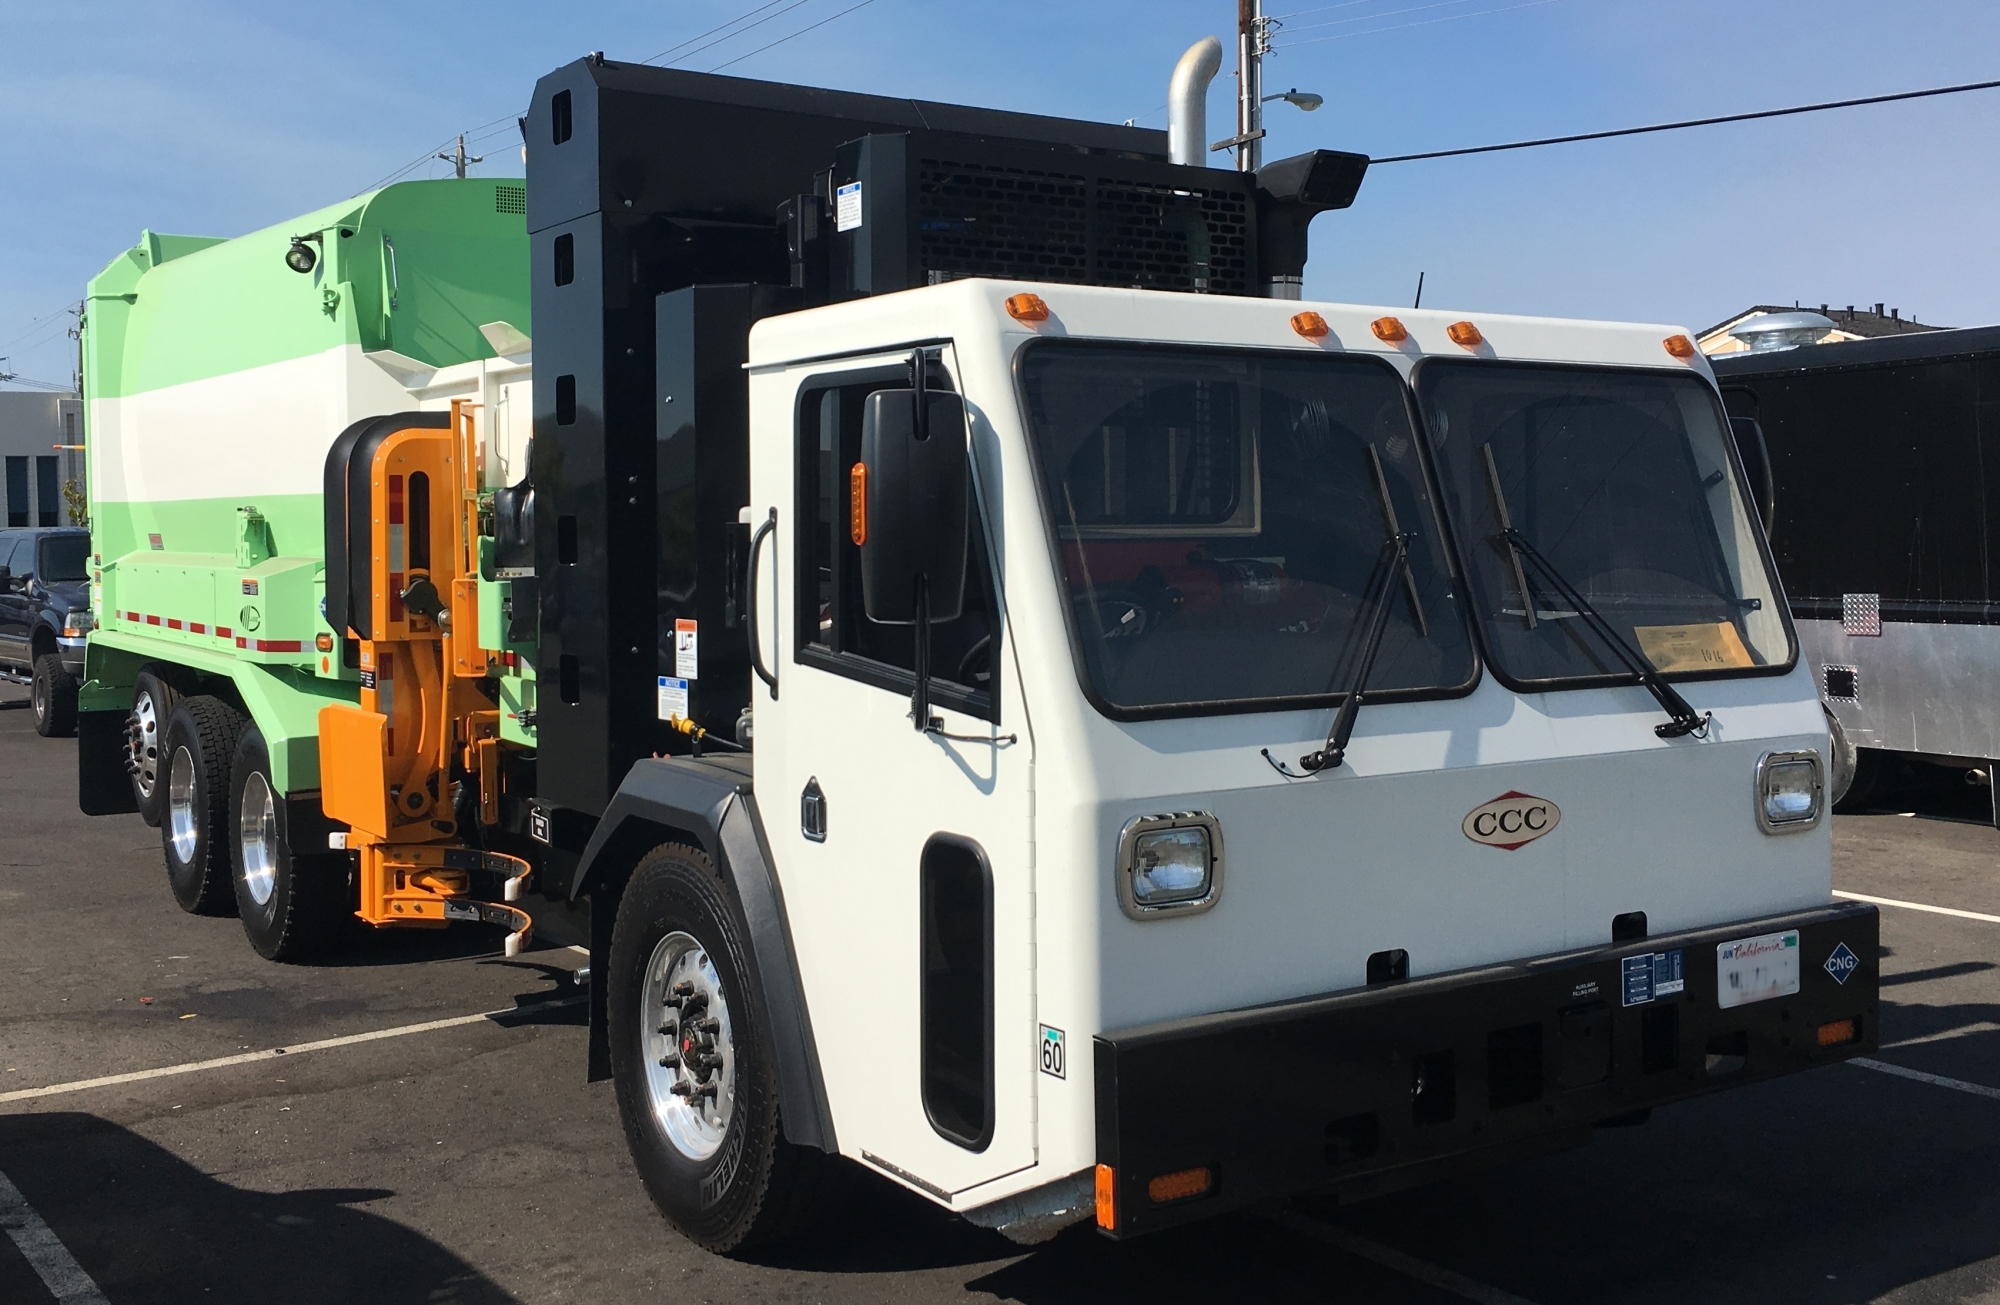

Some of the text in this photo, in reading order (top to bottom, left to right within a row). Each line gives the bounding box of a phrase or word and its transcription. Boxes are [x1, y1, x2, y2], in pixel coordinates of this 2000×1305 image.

[1473, 806, 1547, 836] CCC
[1722, 949, 1734, 959] JUN
[1734, 941, 1785, 960] California
[1828, 955, 1853, 971] CNG
[1042, 1038, 1062, 1073] 60
[701, 1093, 748, 1205] MICHELIN
